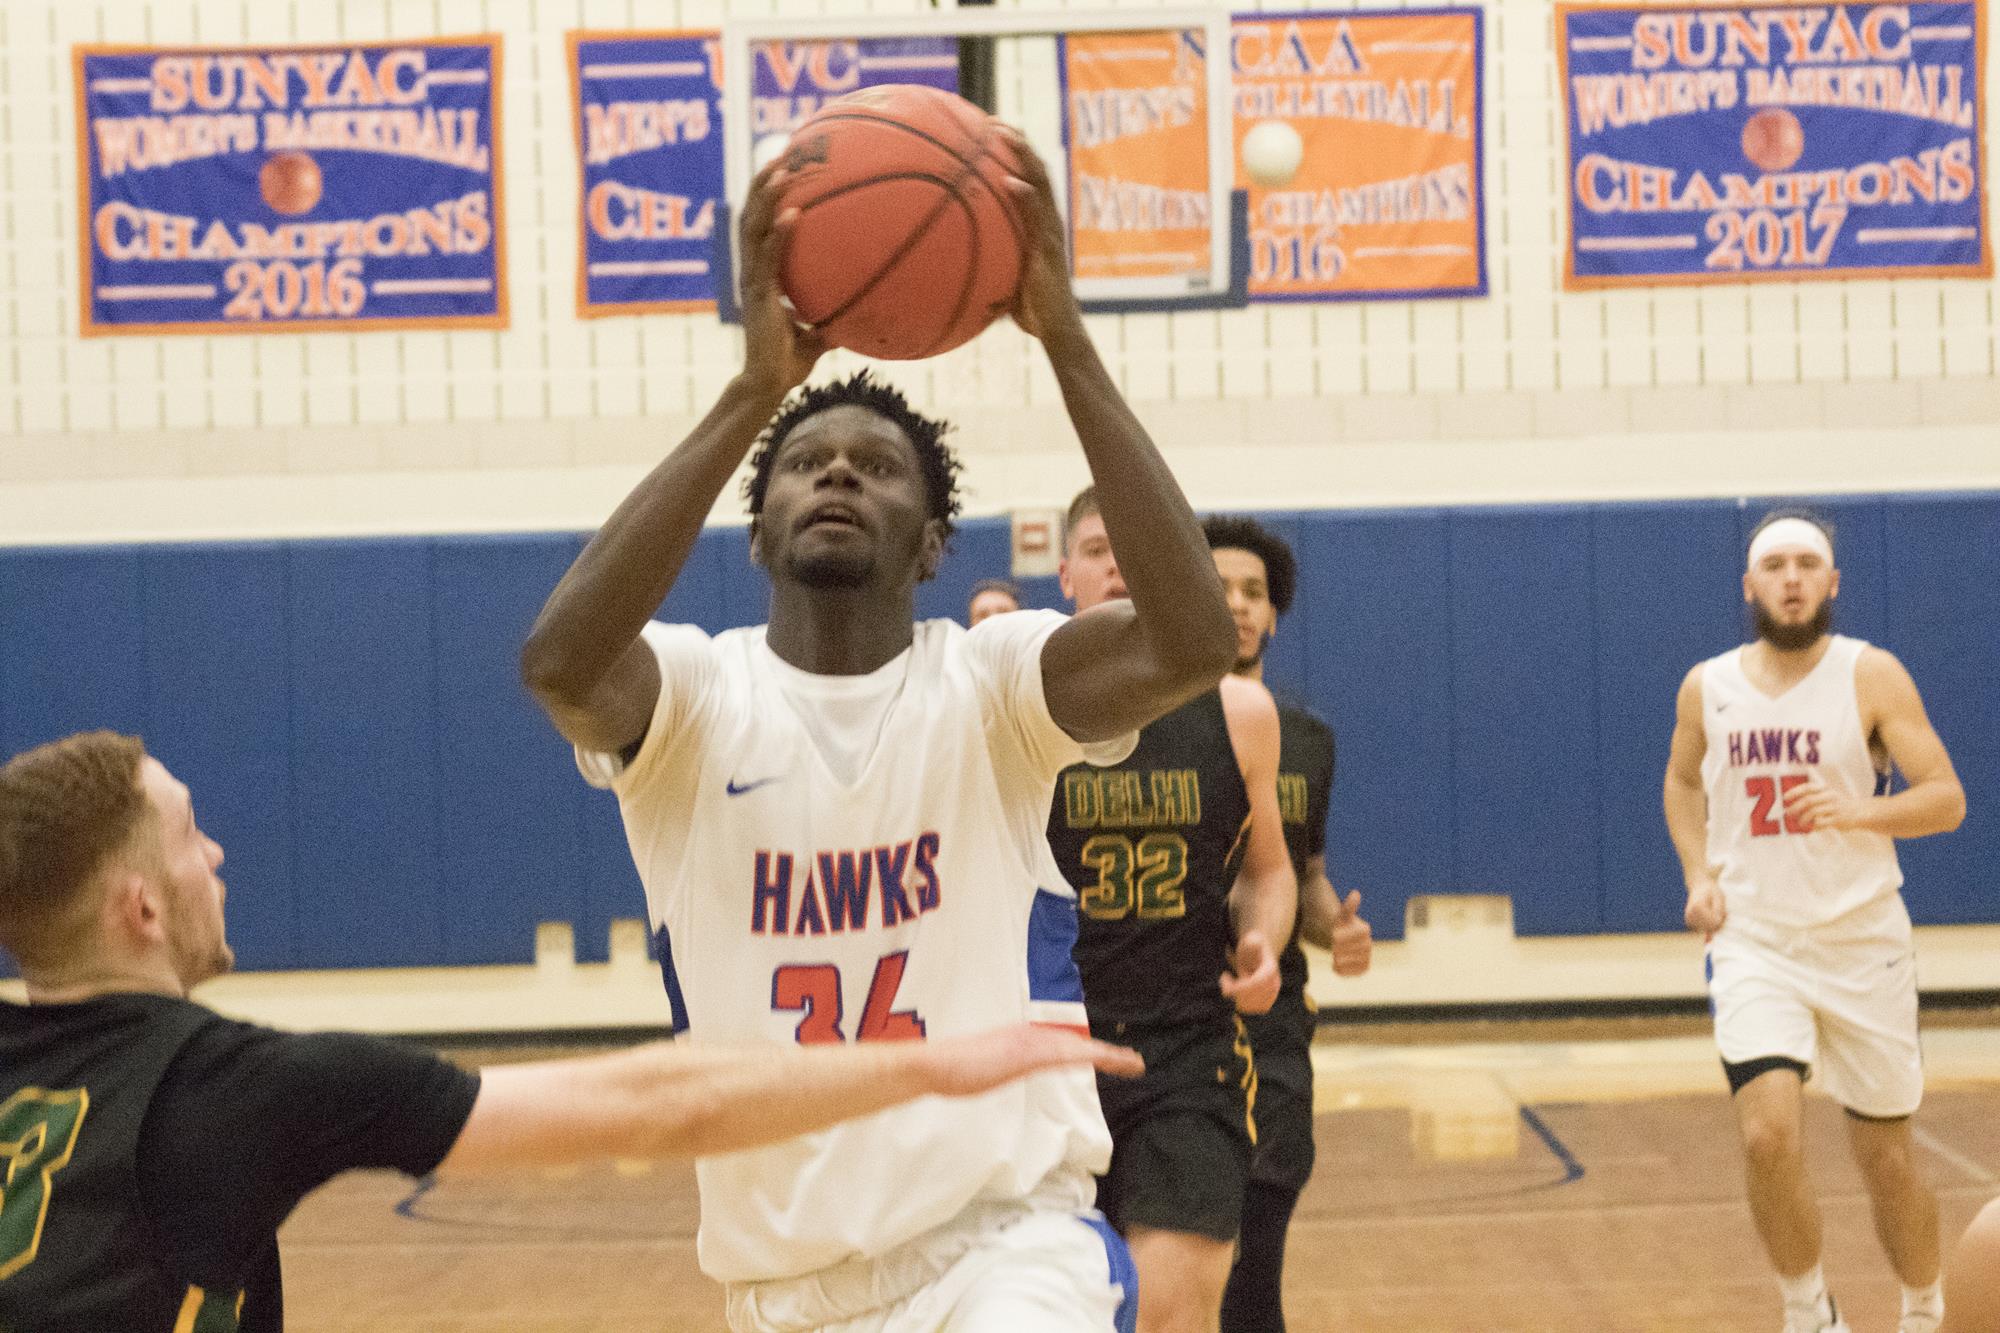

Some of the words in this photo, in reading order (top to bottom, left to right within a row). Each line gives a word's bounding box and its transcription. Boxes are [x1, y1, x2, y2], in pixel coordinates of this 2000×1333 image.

[1632, 5, 1911, 69] SUNYAC
[151, 49, 427, 112] SUNYAC
[1075, 84, 1196, 147] MEN'S
[1231, 79, 1470, 140] OLLEYBALL
[1573, 71, 1737, 136] WOMEN'S
[1746, 63, 1973, 128] BASKETBALL
[95, 113, 257, 179] WOMEN'S
[264, 108, 488, 173] BASKETBALL
[585, 99, 711, 165] MEN'S
[1080, 173, 1212, 232] NATION
[1261, 162, 1470, 226] CHAMPIONS
[1577, 138, 1974, 213] CHAMPIONS
[95, 191, 491, 261] CHAMPIONS
[1248, 221, 1347, 284] 016
[1705, 206, 1849, 271] 2017
[224, 258, 366, 321] 2016
[1728, 729, 1821, 768] HAWKS
[1065, 768, 1201, 829] DELHI
[751, 831, 941, 936] HAWKS
[1081, 832, 1189, 921] 32
